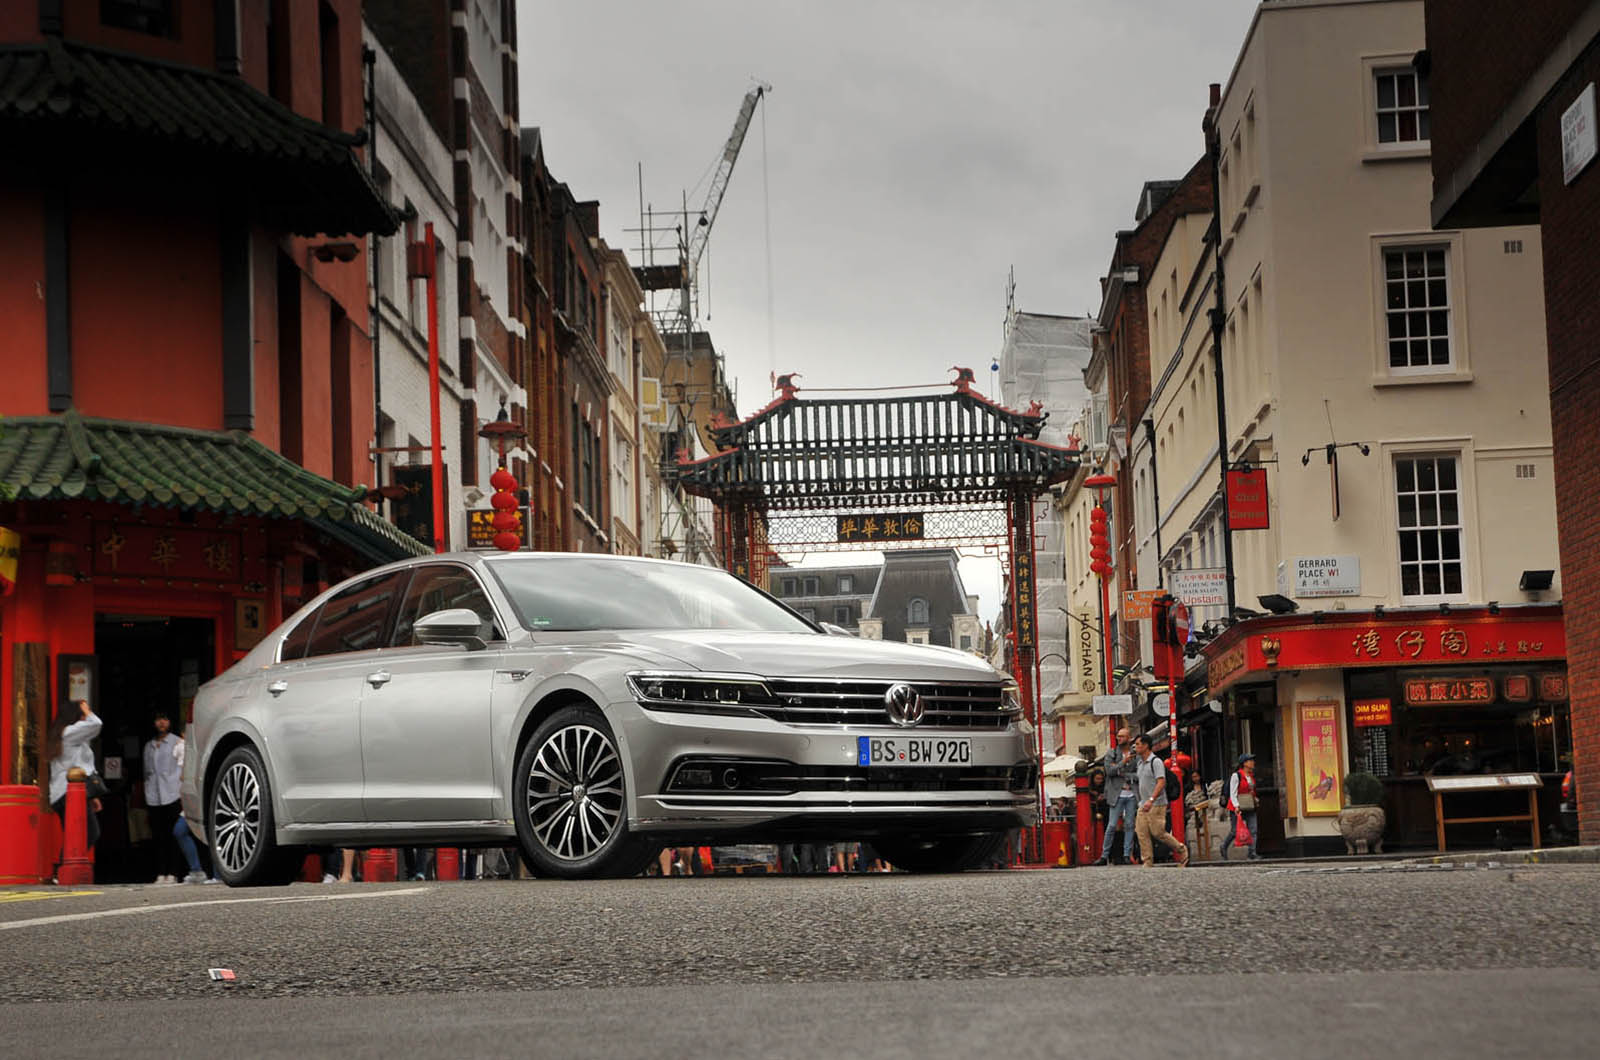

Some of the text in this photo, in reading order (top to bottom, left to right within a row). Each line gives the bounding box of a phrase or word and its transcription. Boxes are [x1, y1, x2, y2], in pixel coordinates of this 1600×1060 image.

[1298, 559, 1337, 568] GERRARD
[1299, 568, 1339, 578] PLACE W1
[1184, 594, 1225, 605] Upstairs
[1080, 613, 1093, 677] HAOZHAN
[1371, 703, 1389, 712] SUM
[871, 740, 970, 763] BS BW 920
